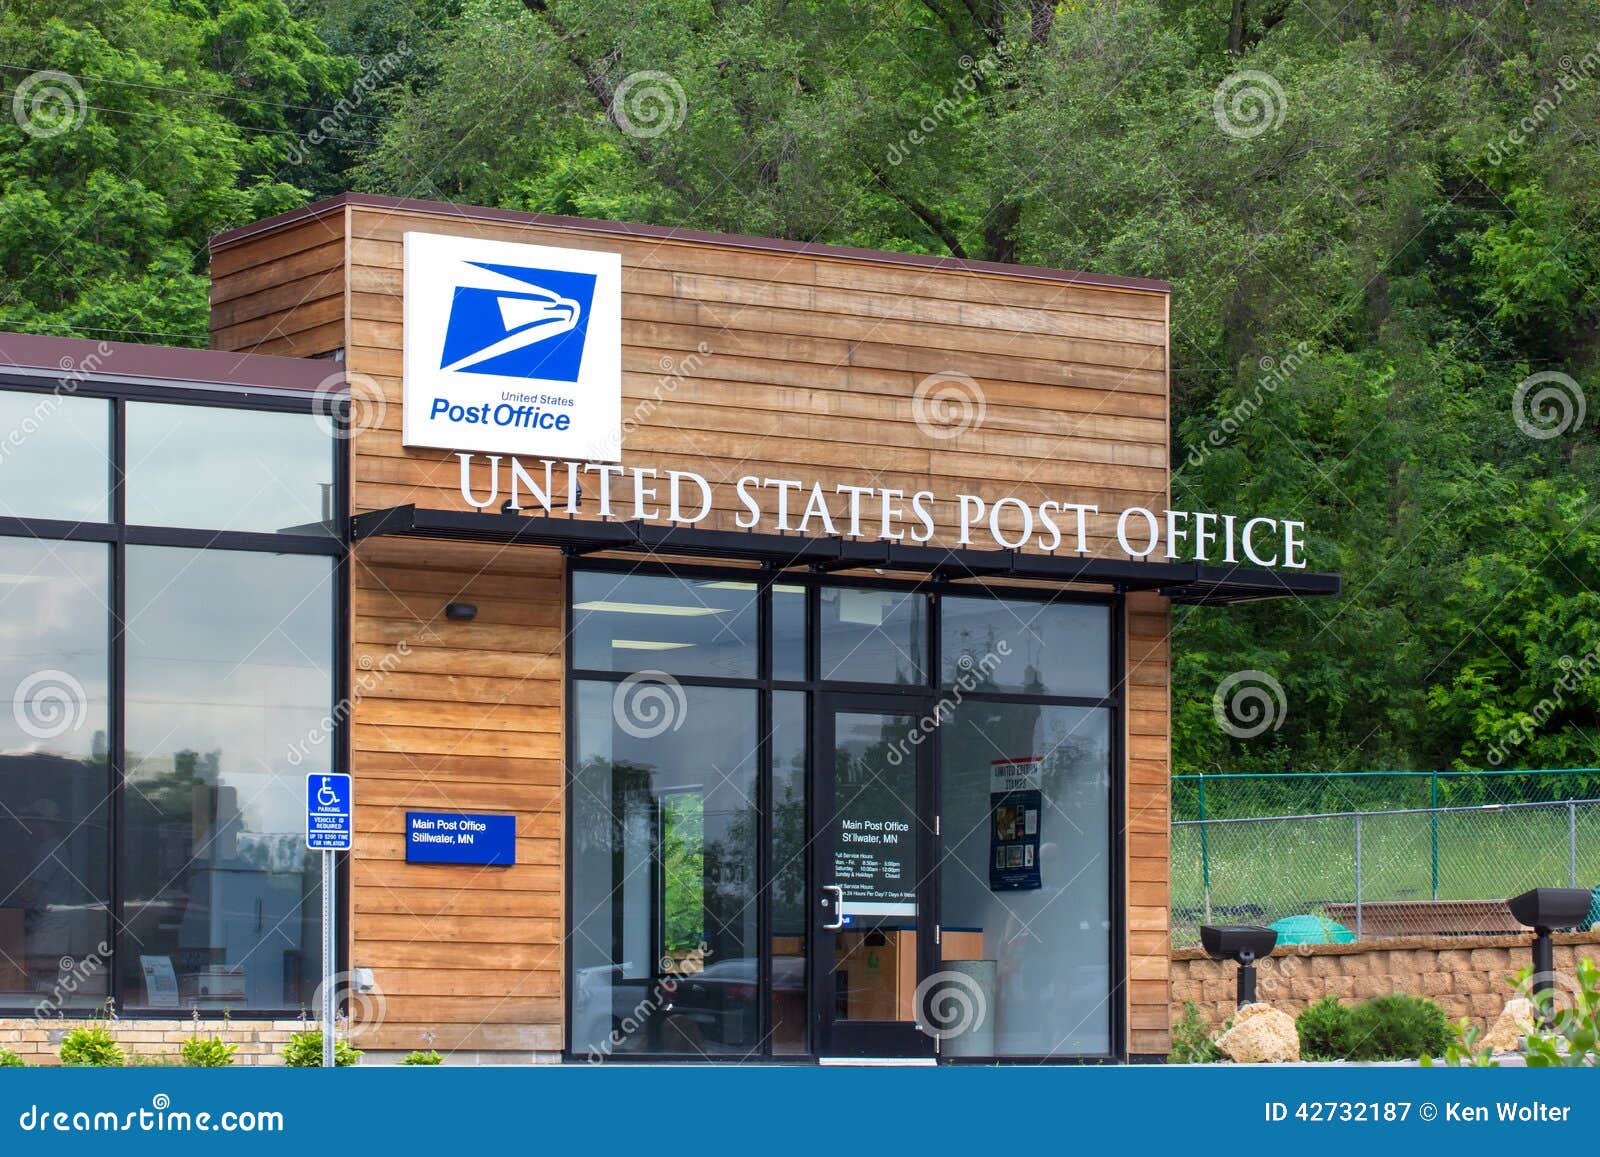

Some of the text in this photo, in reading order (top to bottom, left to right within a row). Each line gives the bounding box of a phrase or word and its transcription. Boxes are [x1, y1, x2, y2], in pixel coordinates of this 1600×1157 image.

[501, 392, 574, 407] United States
[430, 398, 570, 431] Post Office
[454, 453, 1307, 569] UNITED STATES POST OFFICE
[412, 819, 486, 831] Main Post Office
[842, 820, 909, 832] Main Post Office
[412, 832, 474, 845] Stillwater, MN
[884, 834, 898, 844] MN
